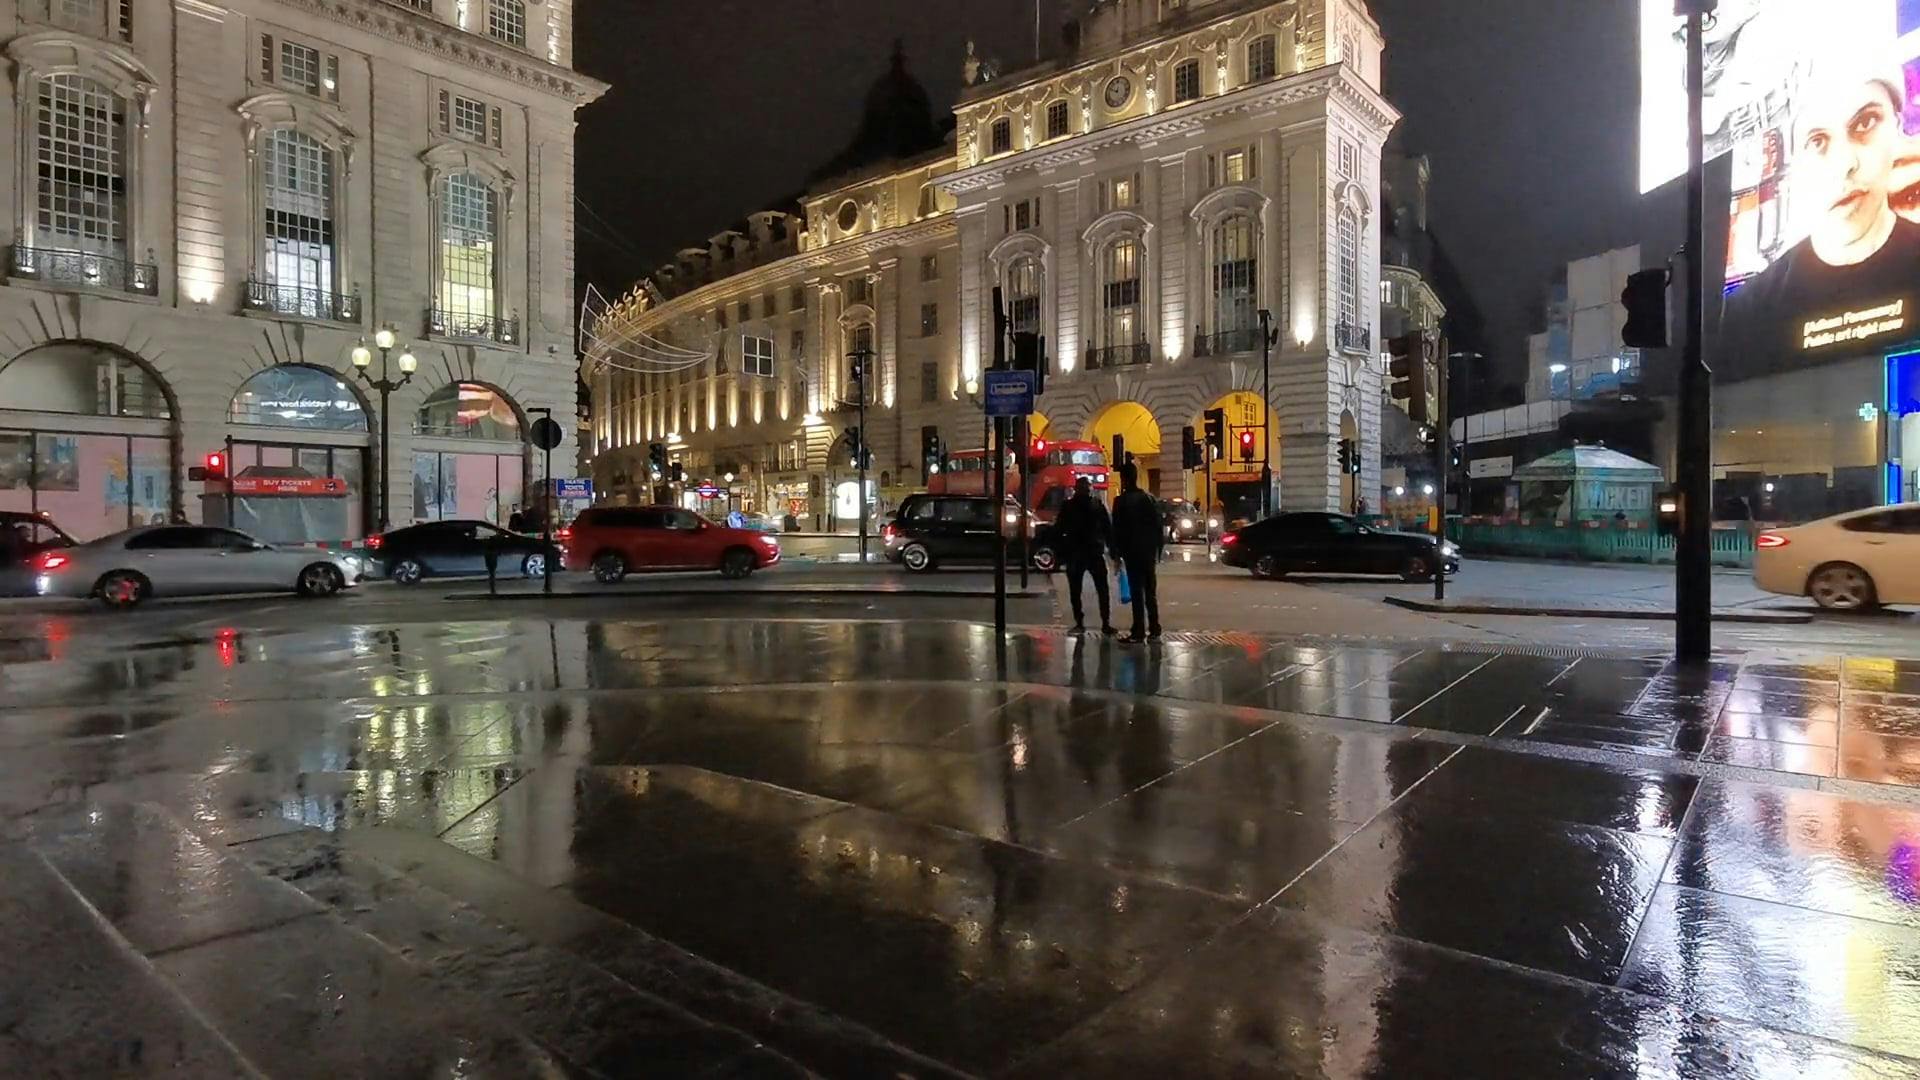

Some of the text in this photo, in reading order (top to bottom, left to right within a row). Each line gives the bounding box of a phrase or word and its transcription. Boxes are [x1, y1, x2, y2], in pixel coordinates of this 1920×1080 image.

[1835, 328, 1851, 342] art
[1851, 322, 1878, 339] right
[1879, 318, 1904, 332] now
